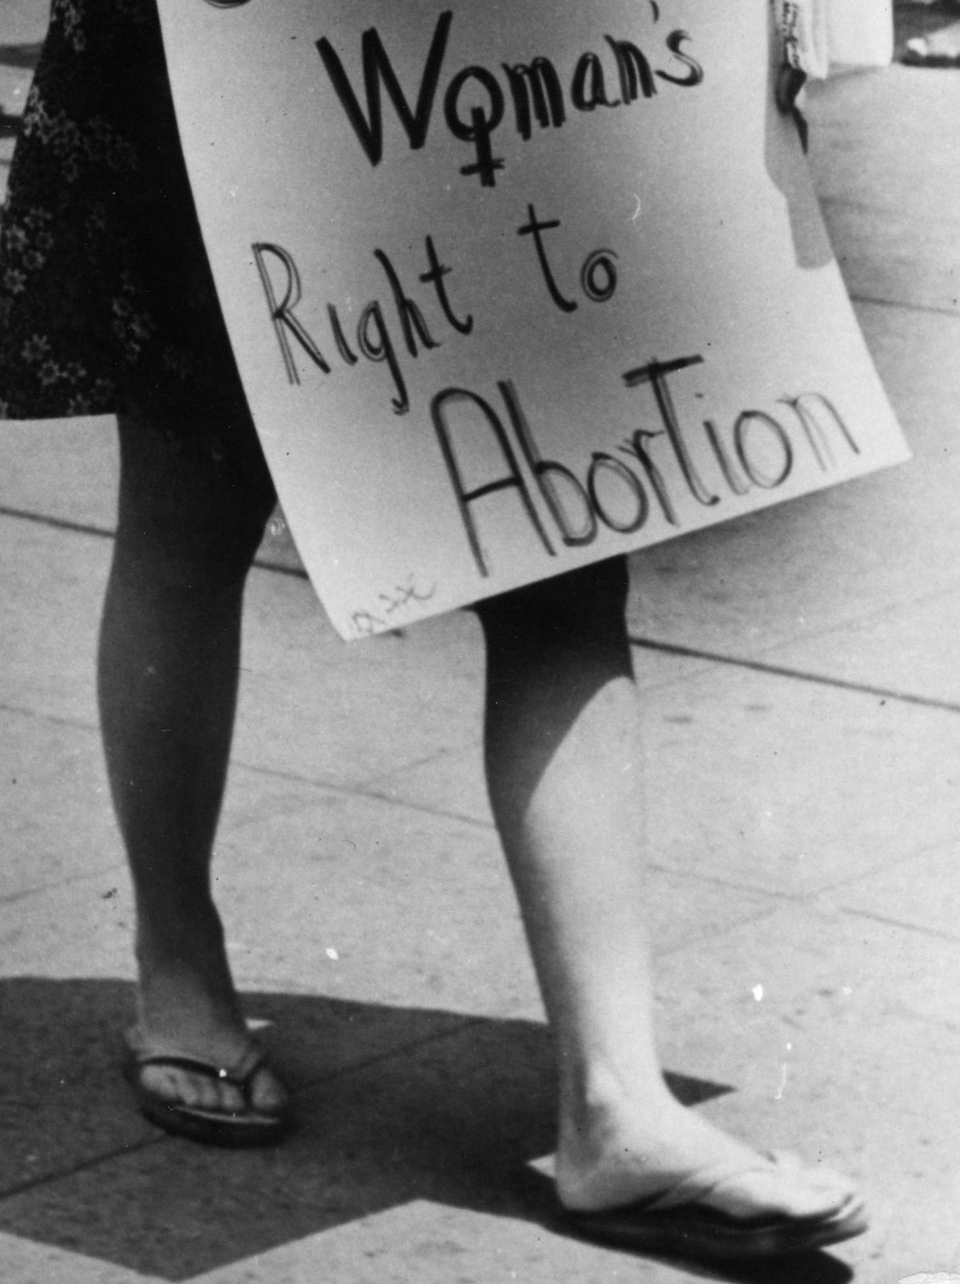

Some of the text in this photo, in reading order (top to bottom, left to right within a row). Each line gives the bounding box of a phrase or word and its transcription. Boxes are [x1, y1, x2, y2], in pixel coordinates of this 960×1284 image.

[314, 0, 704, 188] Woman's
[250, 203, 619, 416] Right to
